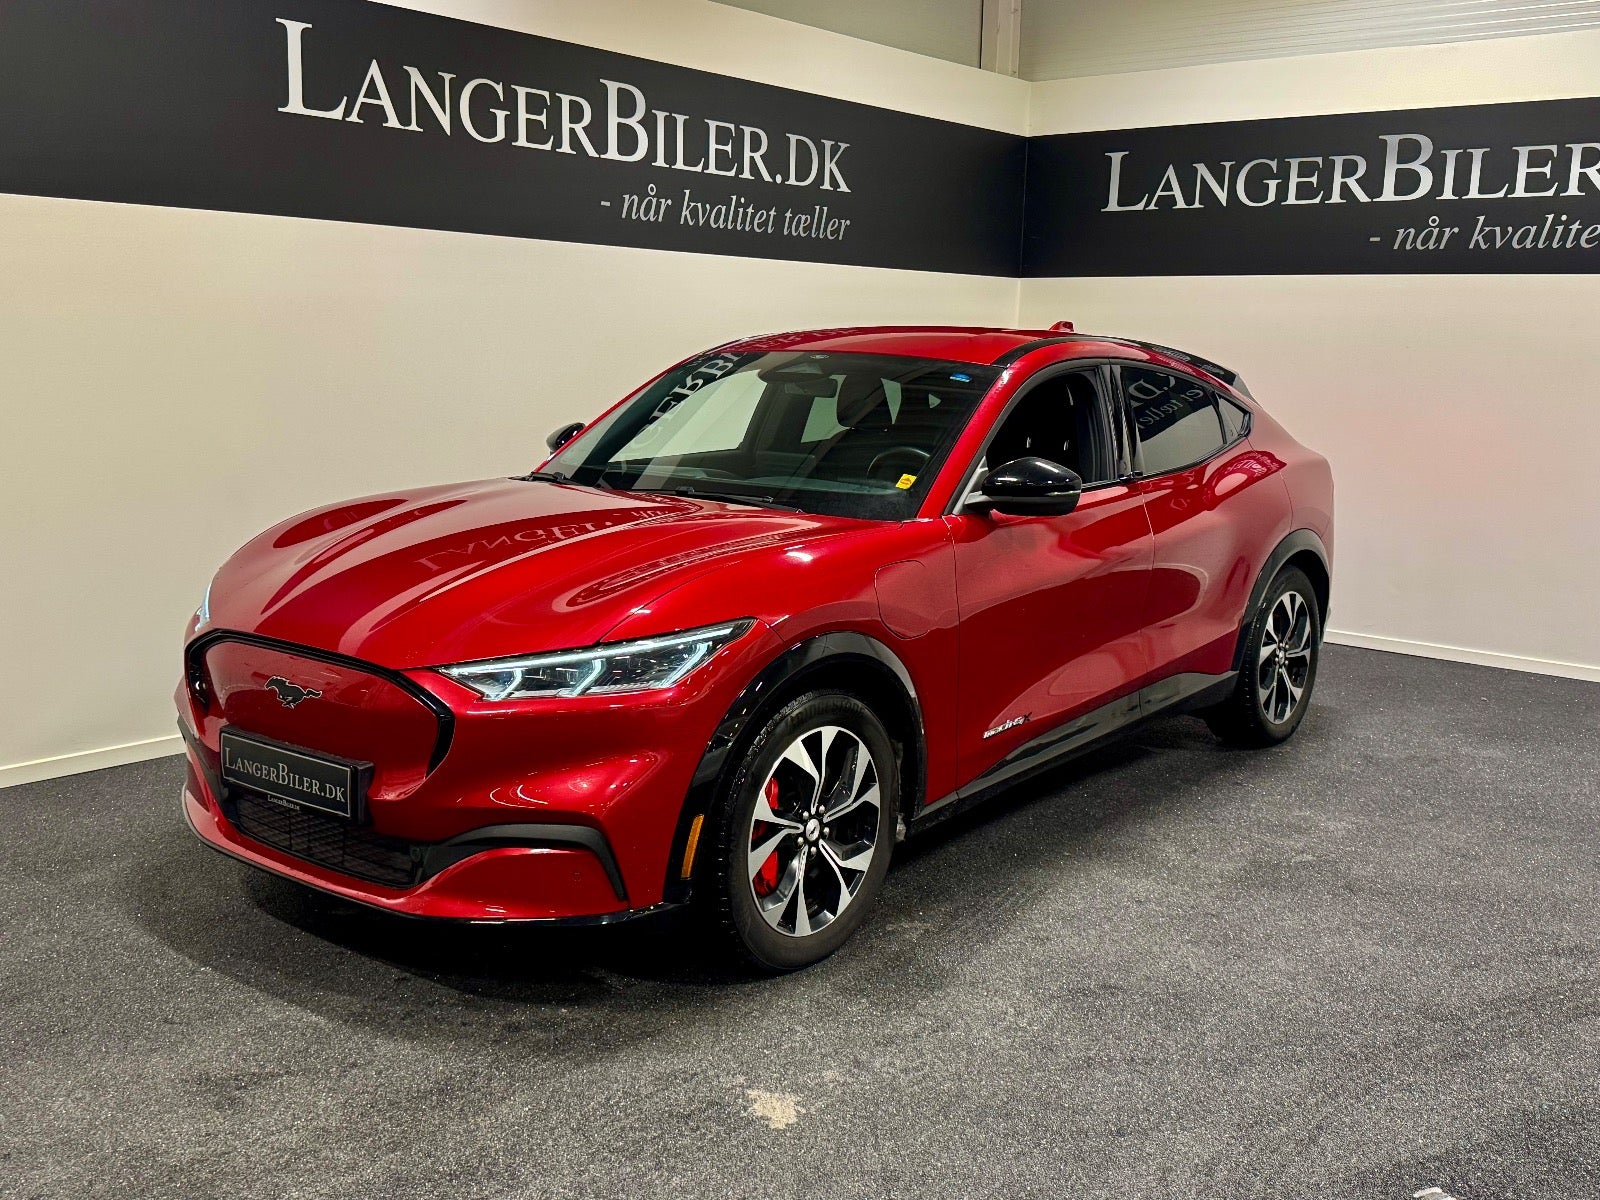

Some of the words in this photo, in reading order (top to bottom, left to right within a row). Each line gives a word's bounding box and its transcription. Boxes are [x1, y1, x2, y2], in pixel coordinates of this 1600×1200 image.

[621, 184, 673, 223] når
[680, 190, 777, 234] kvalitet
[784, 206, 851, 241] tæller
[1393, 215, 1460, 251] når
[1468, 213, 1600, 250] kvalite
